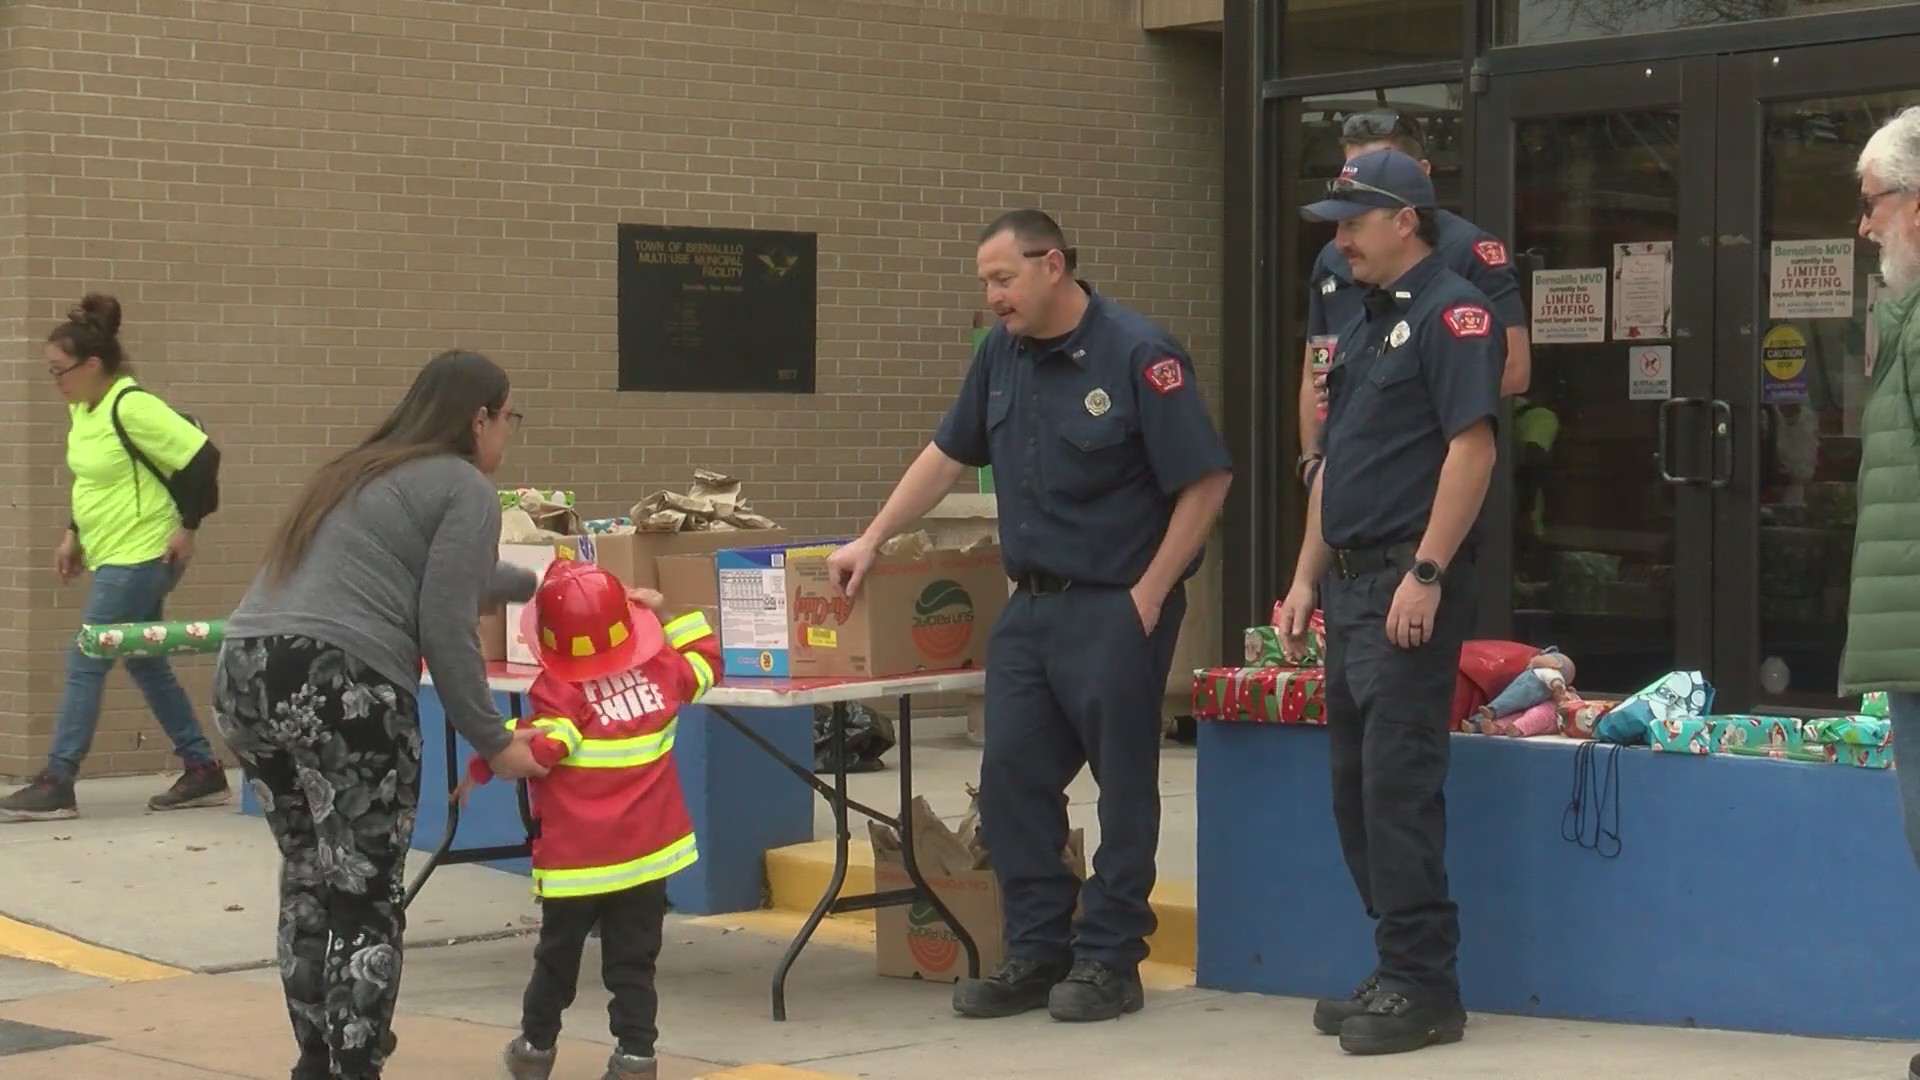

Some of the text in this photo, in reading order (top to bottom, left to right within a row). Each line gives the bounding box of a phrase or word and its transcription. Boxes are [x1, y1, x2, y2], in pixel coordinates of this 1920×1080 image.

[634, 240, 744, 254] TOWN OF BERNALILLO
[1774, 243, 1852, 256] Bernalillo MVD
[702, 266, 743, 278] FACILITY
[1786, 265, 1837, 277] LIMITED
[1580, 273, 1603, 284] MVD
[1781, 277, 1842, 289] STAFFING
[1545, 293, 1590, 305] LIMITED
[1541, 304, 1595, 316] STAFFING
[1767, 348, 1803, 358] CAUTION
